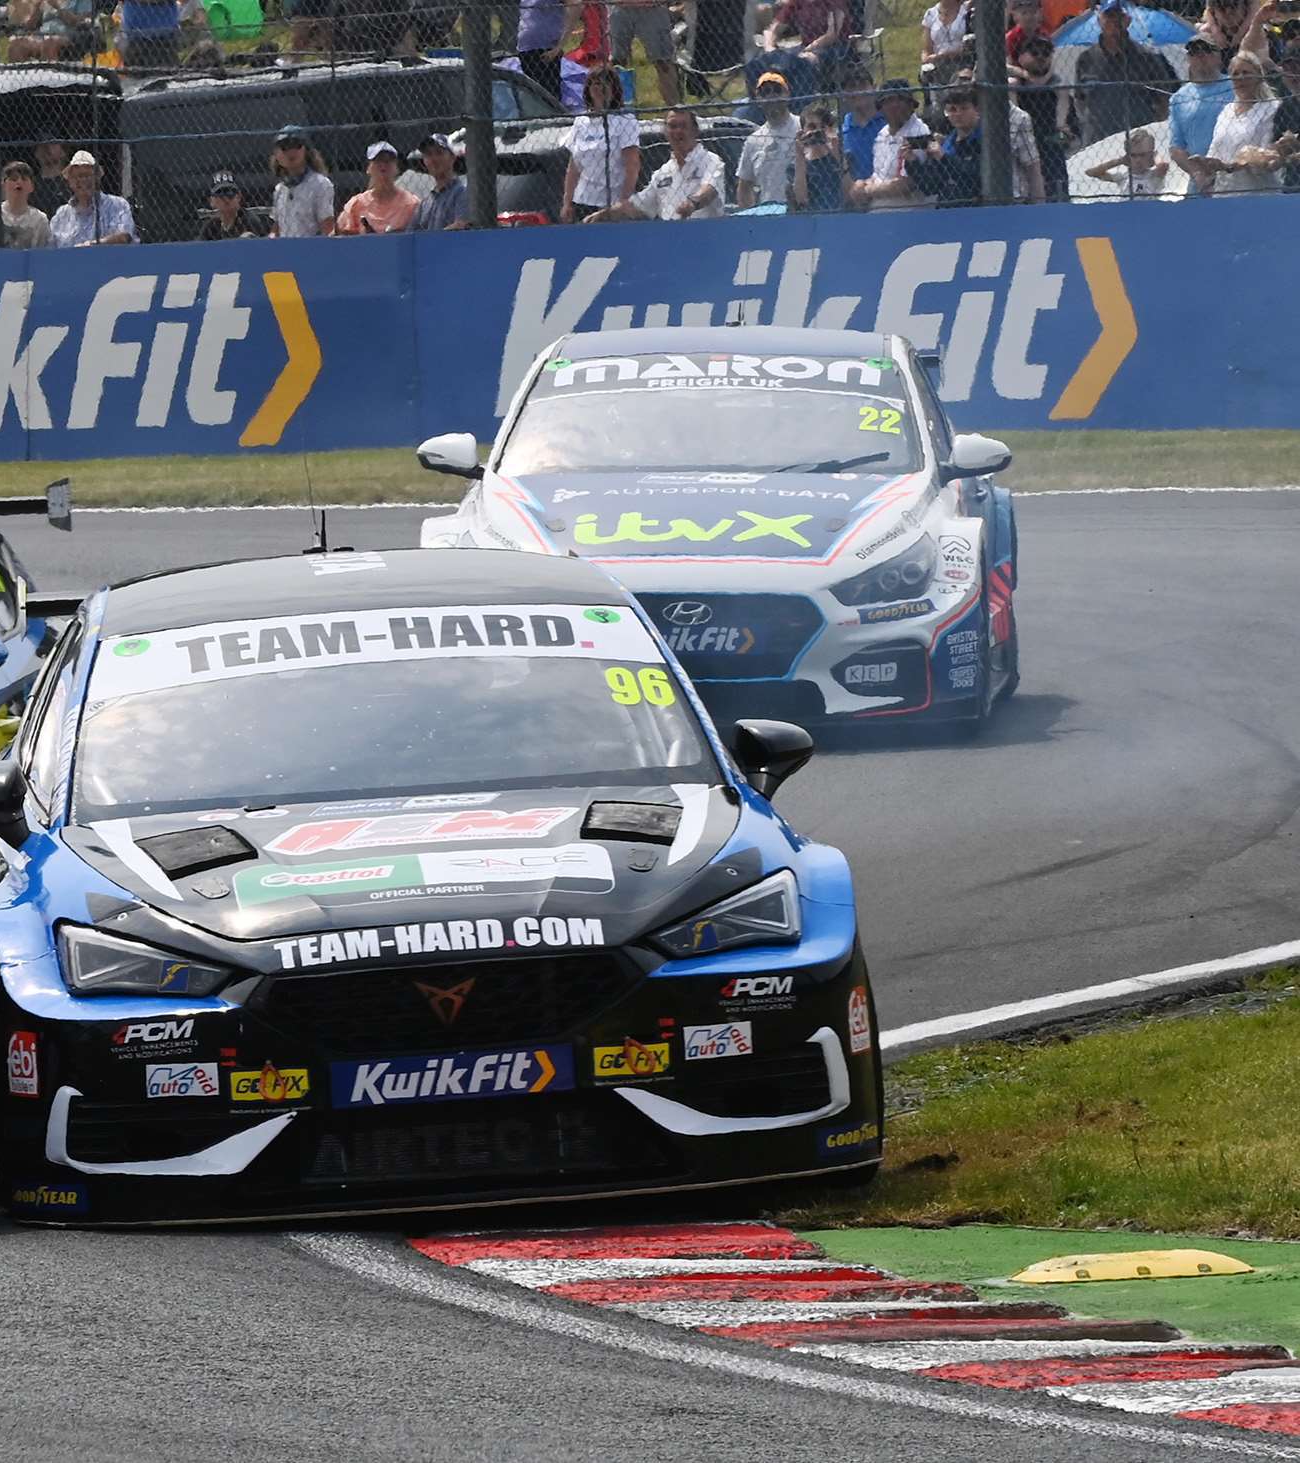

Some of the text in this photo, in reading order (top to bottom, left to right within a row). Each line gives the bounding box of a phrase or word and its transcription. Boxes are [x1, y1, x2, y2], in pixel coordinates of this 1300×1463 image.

[647, 376, 784, 389] FREIGHT UK
[859, 406, 901, 434] 22
[176, 614, 596, 674] TEAM-HARD.
[604, 666, 676, 707] 96
[370, 883, 484, 899] OFFICIAL PARTNER
[273, 918, 605, 970] TEAM-HARD.COM
[688, 1029, 750, 1058] auto aid
[150, 1069, 217, 1095] auto aid
